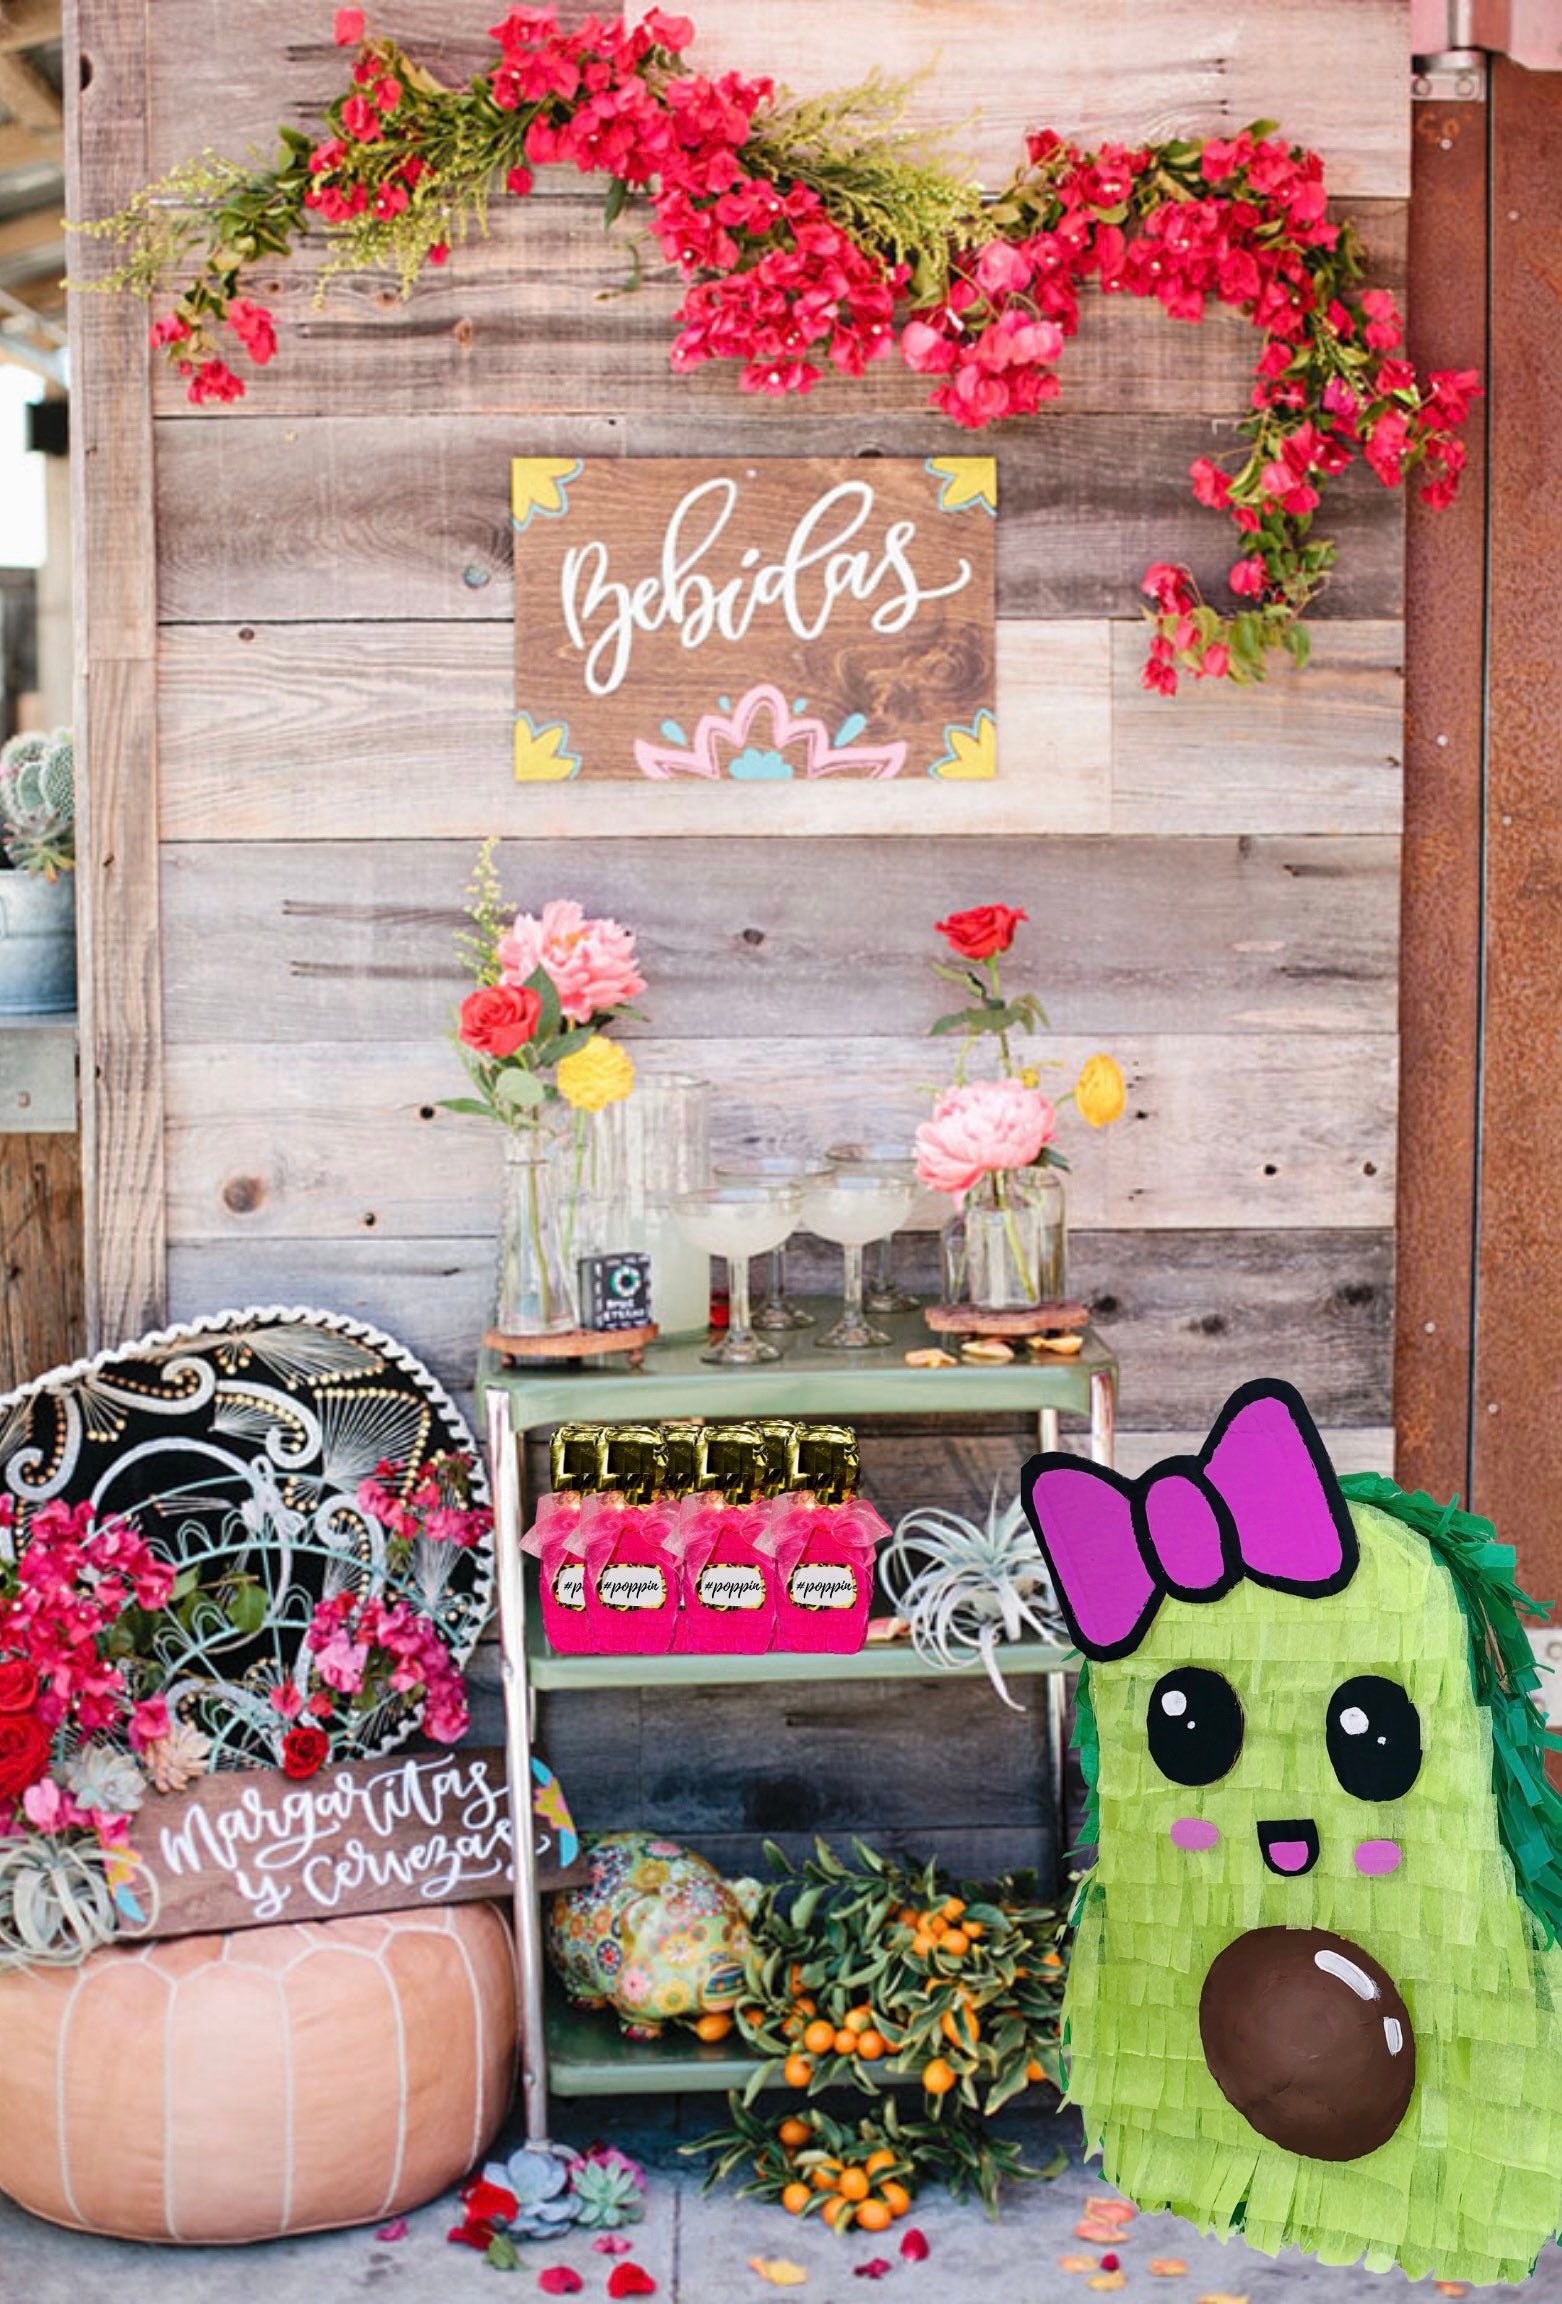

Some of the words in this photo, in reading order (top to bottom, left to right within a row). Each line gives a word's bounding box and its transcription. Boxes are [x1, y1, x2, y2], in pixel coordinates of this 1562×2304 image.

[561, 477, 972, 695] Bebidas
[603, 1580, 659, 1599] #poppin
[704, 1580, 761, 1599] #poppin
[796, 1580, 852, 1599] #poppin
[160, 1753, 512, 1876] Margaritas
[236, 1868, 292, 1919] y
